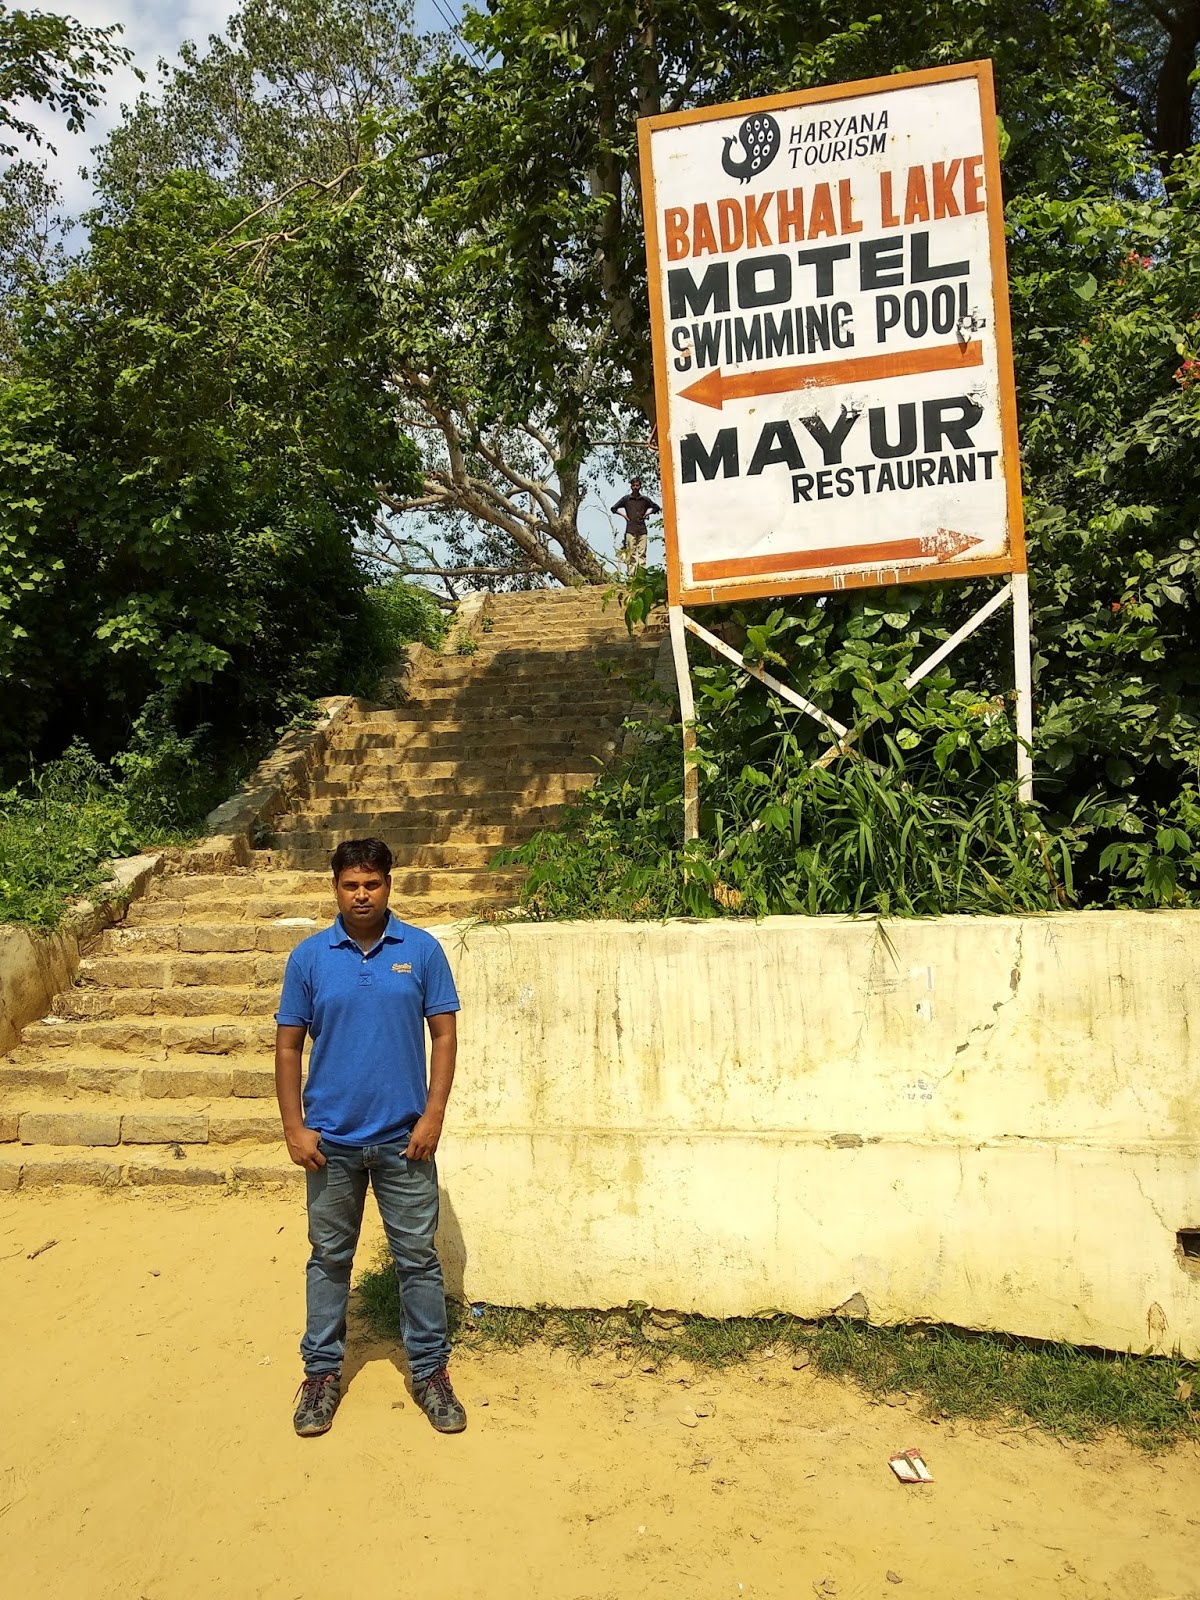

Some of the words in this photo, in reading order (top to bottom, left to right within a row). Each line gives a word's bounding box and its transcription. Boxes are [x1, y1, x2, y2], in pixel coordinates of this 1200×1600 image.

[788, 110, 889, 144] HARYANA
[788, 133, 887, 169] TOURISM
[664, 178, 863, 261] BADKHAL
[880, 155, 986, 229] LAKE
[667, 231, 970, 320] MOTEL
[671, 301, 855, 372] SWIMMING
[680, 395, 984, 484] MAYUR
[791, 450, 999, 504] RESTAURANT
